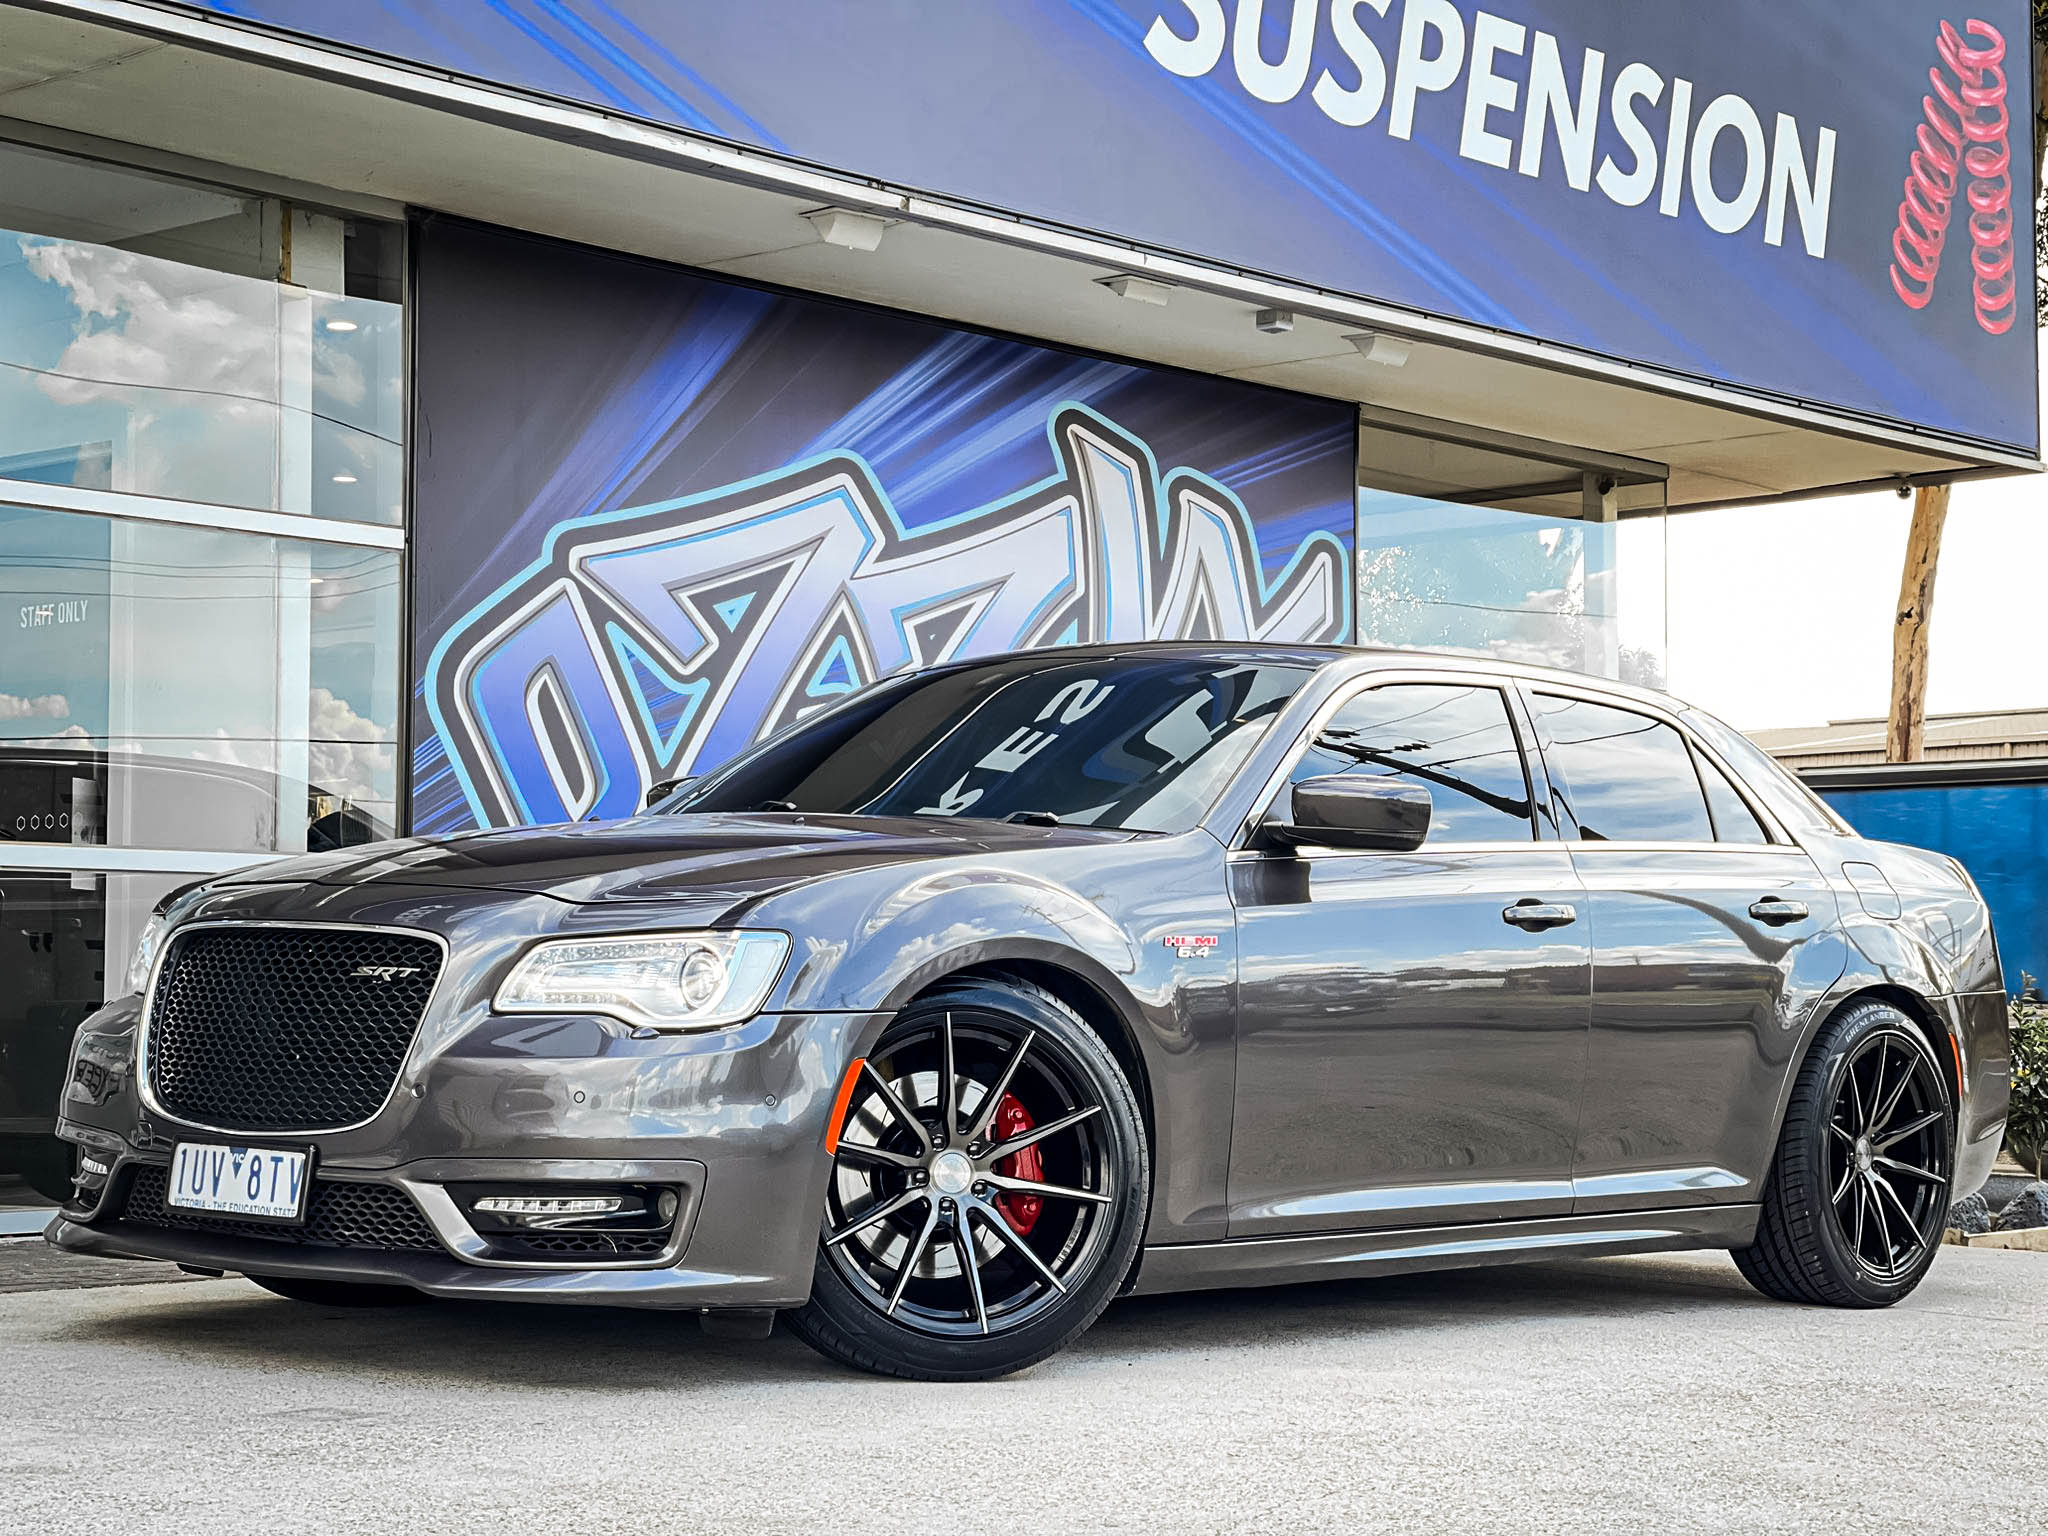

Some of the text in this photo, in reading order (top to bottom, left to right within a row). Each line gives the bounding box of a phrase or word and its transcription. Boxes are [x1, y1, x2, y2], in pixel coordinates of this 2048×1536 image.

[1143, 0, 1838, 259] SUSPENSION
[20, 599, 88, 628] STAFF ONLY
[1163, 935, 1219, 947] HEMI
[1176, 946, 1210, 958] 6.4
[350, 965, 421, 982] SRT
[174, 1197, 206, 1208] VICTORIA
[213, 1201, 227, 1210] THE
[228, 1202, 272, 1215] EDUCATION
[272, 1207, 297, 1218] STATE
